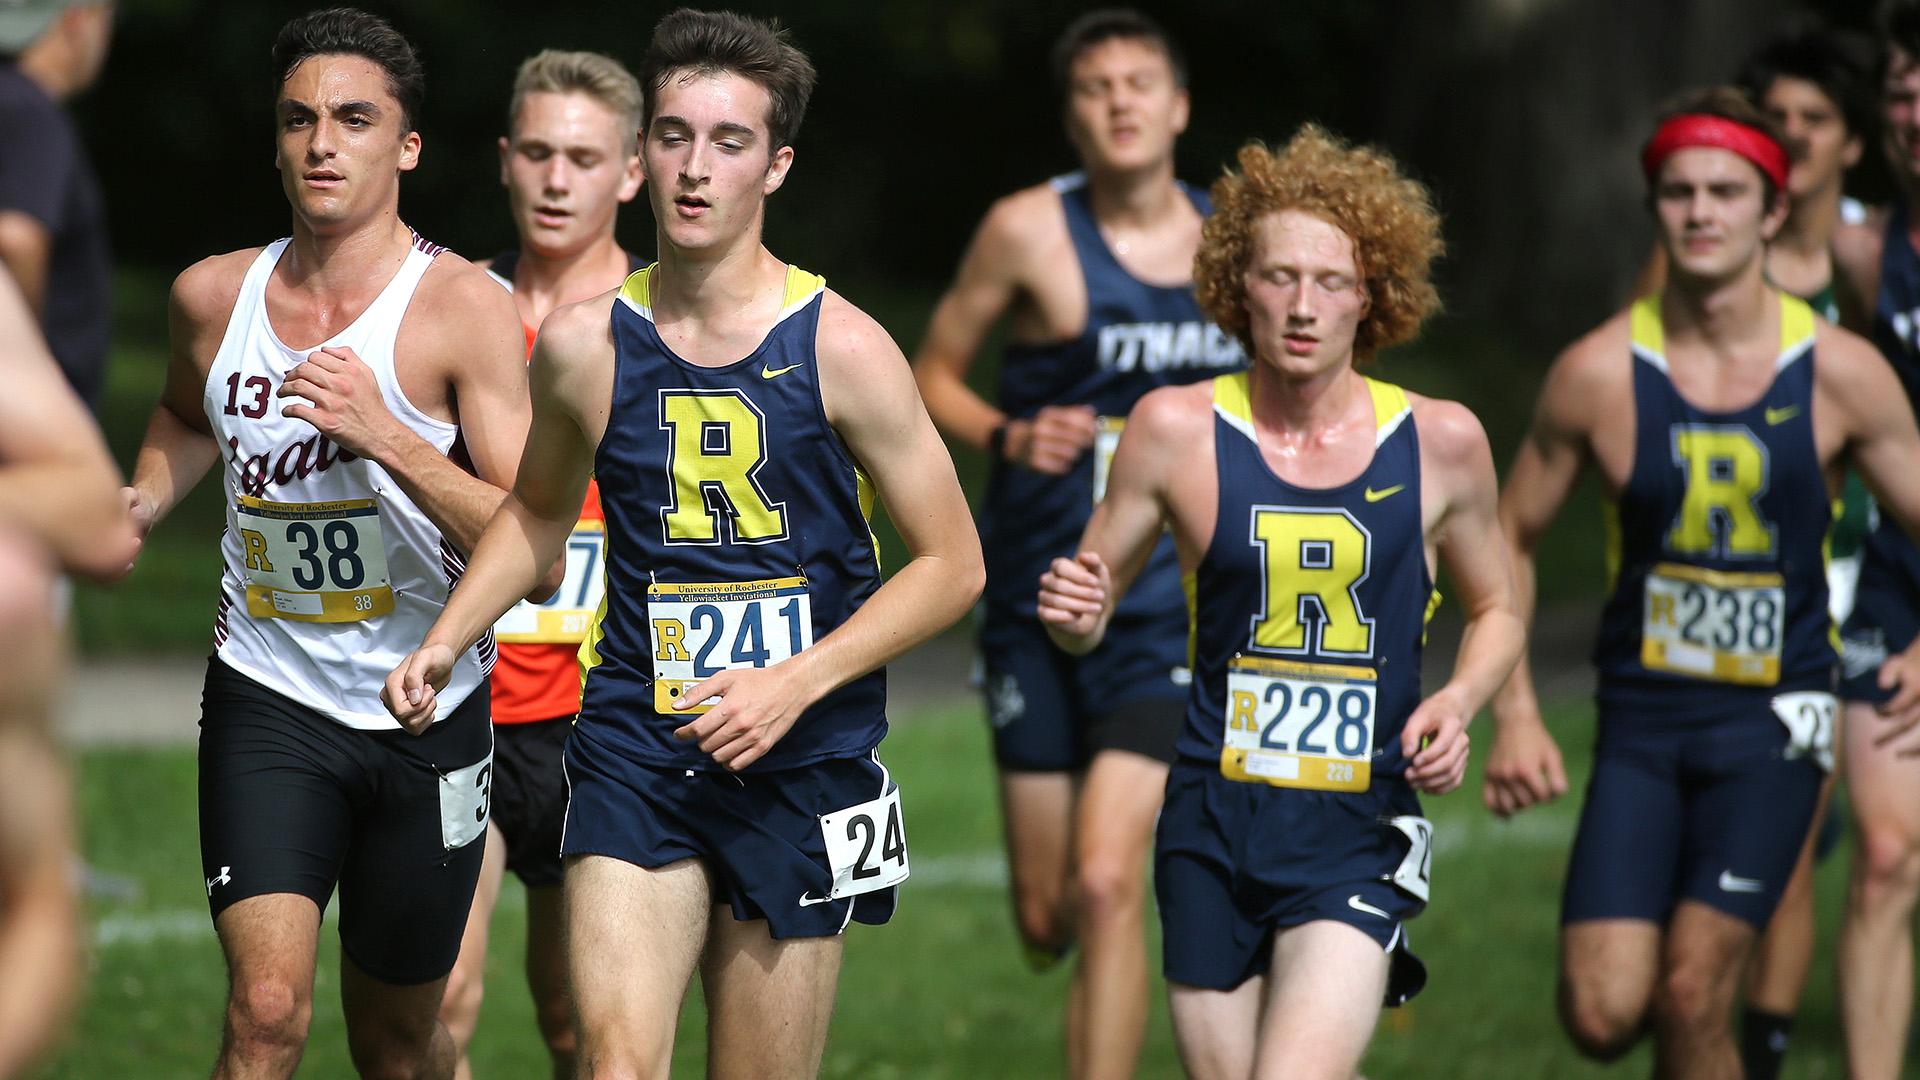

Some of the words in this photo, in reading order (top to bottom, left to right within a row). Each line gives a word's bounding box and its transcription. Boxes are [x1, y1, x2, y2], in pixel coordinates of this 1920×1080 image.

[224, 372, 271, 419] 13
[658, 388, 790, 546] R
[258, 501, 294, 512] University
[296, 502, 305, 512] of
[306, 503, 347, 512] Rochester
[1664, 423, 1778, 560] R
[302, 511, 347, 520] Invitational
[241, 528, 274, 573] R
[286, 521, 365, 590] 38
[353, 594, 373, 611] 38
[678, 585, 721, 594] University
[724, 584, 733, 592] of
[735, 582, 778, 592] Rochester
[679, 594, 728, 603] Yellowjacket
[730, 590, 777, 601] Invitational
[1249, 504, 1376, 659] R
[1651, 593, 1676, 627] R
[1682, 585, 1776, 653] 238
[652, 618, 691, 662] R
[690, 598, 803, 678] 241
[1230, 690, 1258, 732] R
[1260, 682, 1371, 757] 228
[1326, 762, 1354, 782] 228
[846, 801, 905, 881] 24
